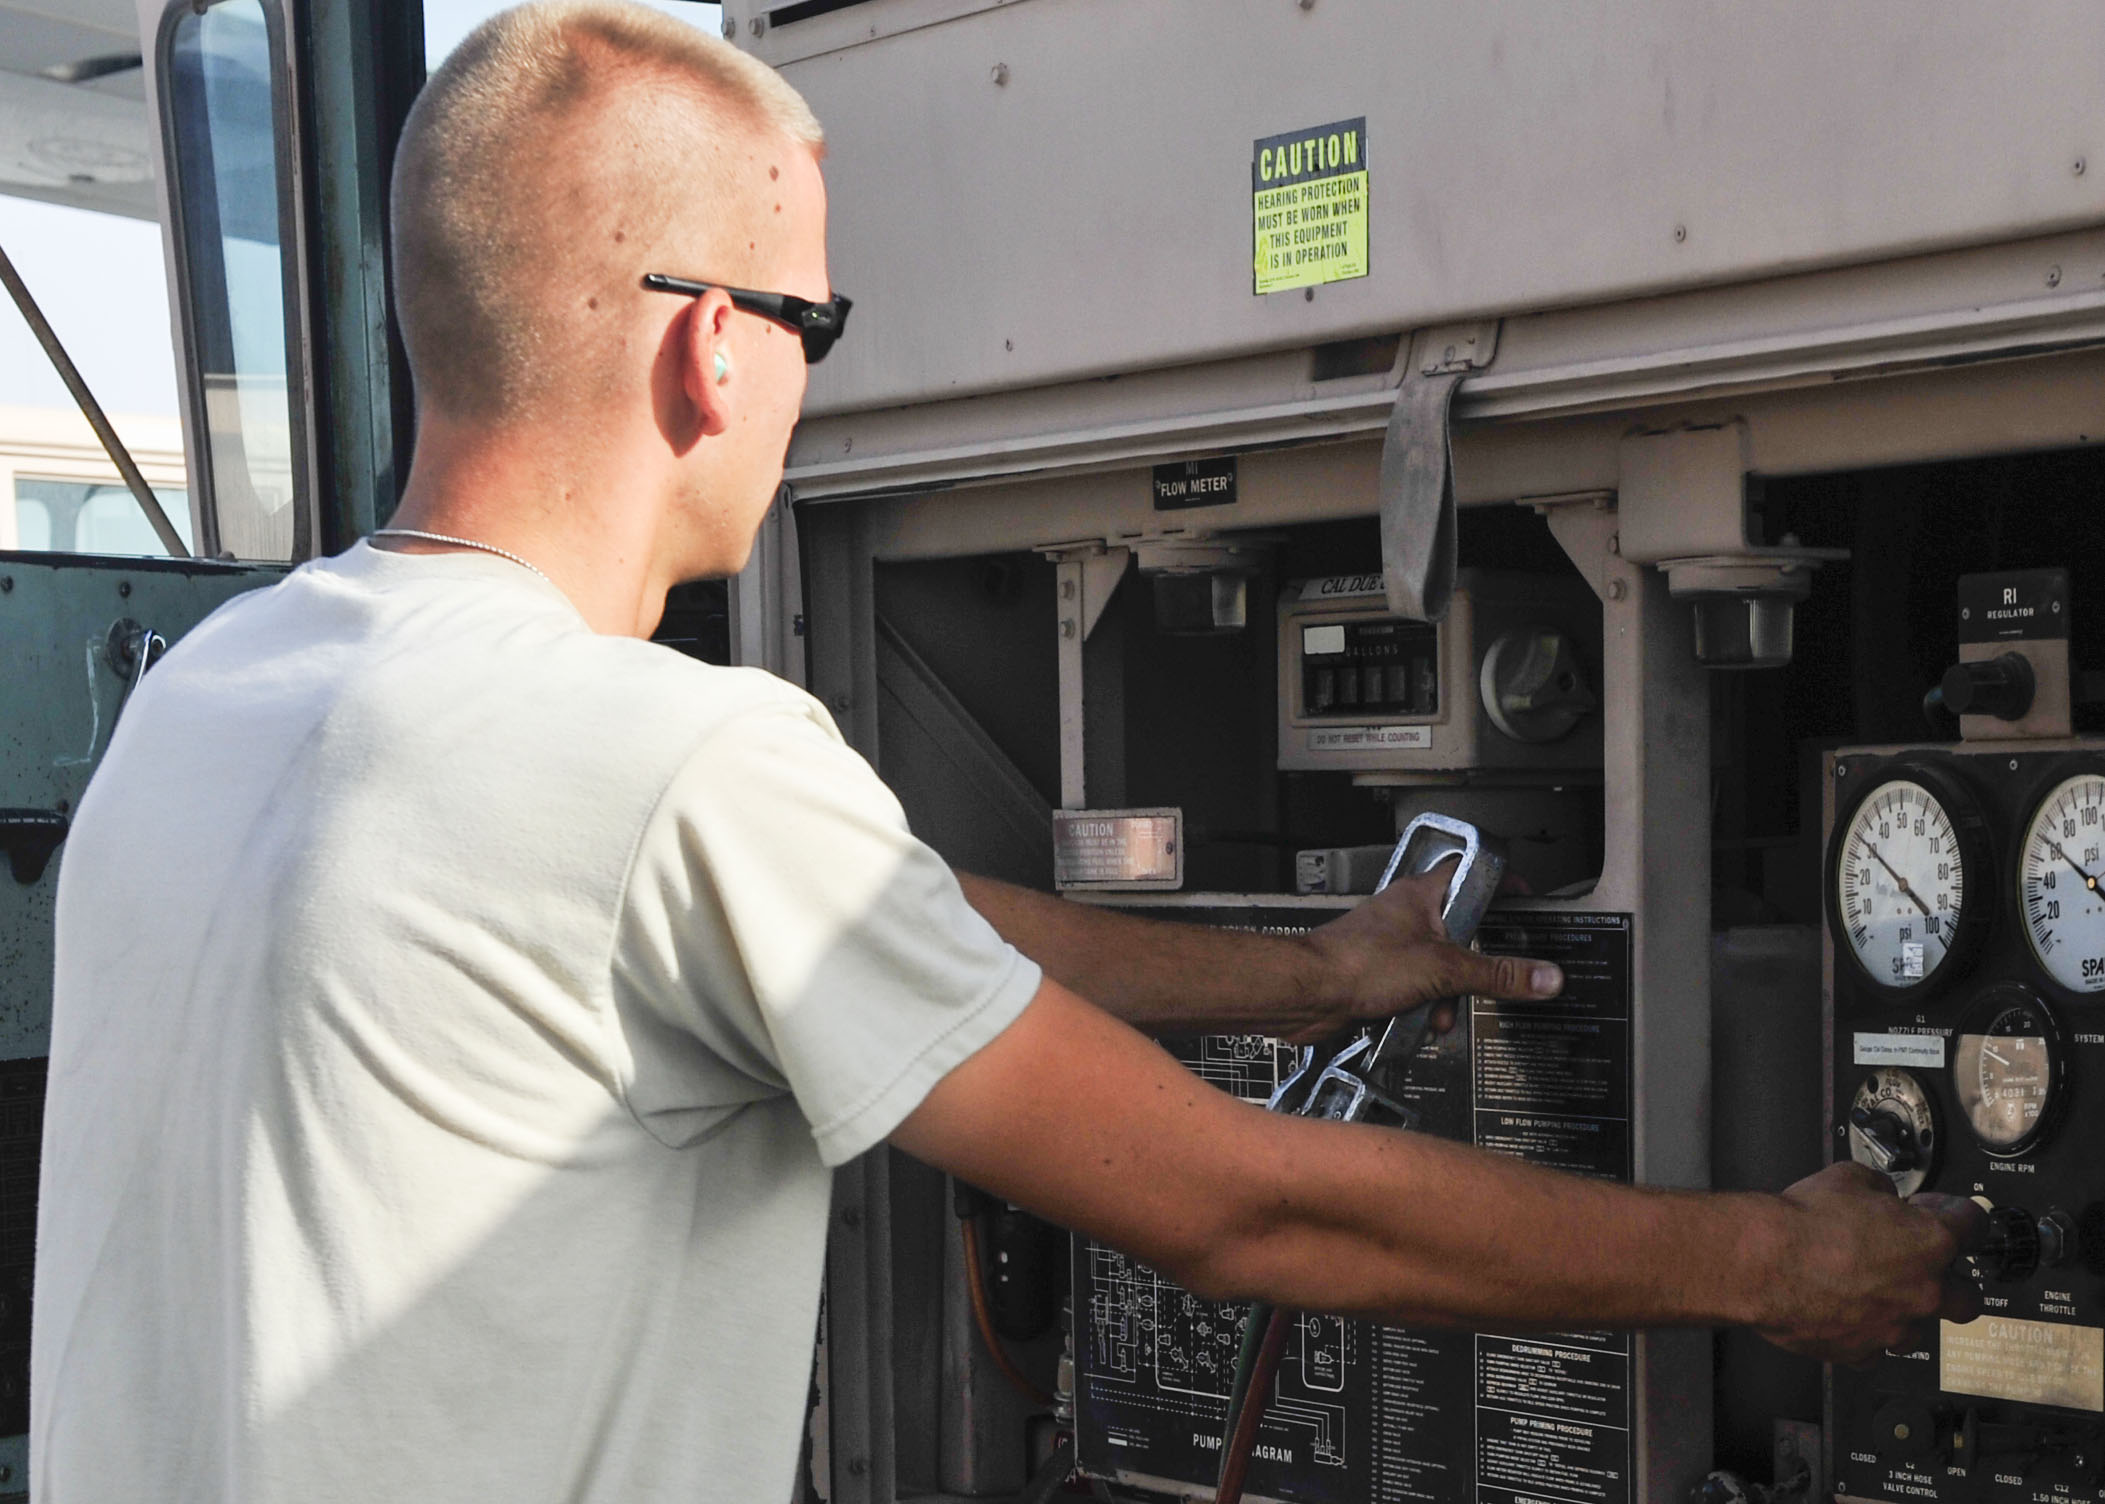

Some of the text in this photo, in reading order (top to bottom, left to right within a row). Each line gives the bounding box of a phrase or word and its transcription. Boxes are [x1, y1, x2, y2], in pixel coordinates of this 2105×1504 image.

[1260, 131, 1357, 181] CAUTION
[1258, 176, 1360, 211] HEARING PROTECTION
[1258, 197, 1361, 231] MUST BE WORN WHEN
[1270, 221, 1348, 249] THIS EQUIPMENT
[1270, 241, 1348, 269] IS IN OPERATION
[1161, 476, 1228, 497] FLOW METER
[1321, 575, 1380, 594] CAL DUE
[1987, 607, 2035, 620] REGULATOR
[1328, 734, 1341, 744] NOT
[1366, 733, 1385, 743] WHILE
[1388, 732, 1420, 743] COUNTING
[1897, 813, 1908, 829] 50
[2080, 806, 2098, 826] 100
[1068, 823, 1113, 837] CAUTION
[1879, 822, 1890, 839] 40
[1914, 819, 1925, 836] 60
[2063, 819, 2076, 838] 80
[1929, 838, 1940, 854] 70
[2050, 842, 2063, 861] 60
[2084, 842, 2100, 866] psi
[1860, 868, 1871, 885] 20
[1937, 863, 1949, 880] 80
[2043, 871, 2056, 890] 40
[1863, 898, 1872, 915] 10
[1937, 893, 1948, 911] 90
[2047, 900, 2060, 920] 20
[1574, 915, 1621, 925] INSTRUCTIONS
[1924, 916, 1940, 934] 100
[1899, 923, 1912, 941] psi
[2074, 1033, 2105, 1044] SYSTEM
[1501, 1116, 1600, 1132] LOW FLOW PUMPING PROCEDURE
[1990, 1161, 2035, 1174] ENGINE RPM
[1973, 1182, 1984, 1192] ON
[2044, 1290, 2072, 1302] ENGINE
[2039, 1303, 2077, 1316] THROTTLE
[1988, 1321, 2053, 1344] CAUTION
[1554, 1350, 1591, 1363] PROCEDURE
[1510, 1417, 1528, 1427] PUMP
[1556, 1424, 1593, 1437] PROCEDURE
[1193, 1433, 1223, 1450] PUMP
[1850, 1451, 1877, 1464] CLOSED
[1888, 1470, 1933, 1485] 3 INCH HOSE
[1947, 1466, 1967, 1478] OPEN
[1995, 1473, 2023, 1486] CLOSED
[1883, 1482, 1938, 1499] VALVE CONTROL
[2032, 1492, 2050, 1503] 1.50
[2051, 1495, 2070, 1504] INCH
